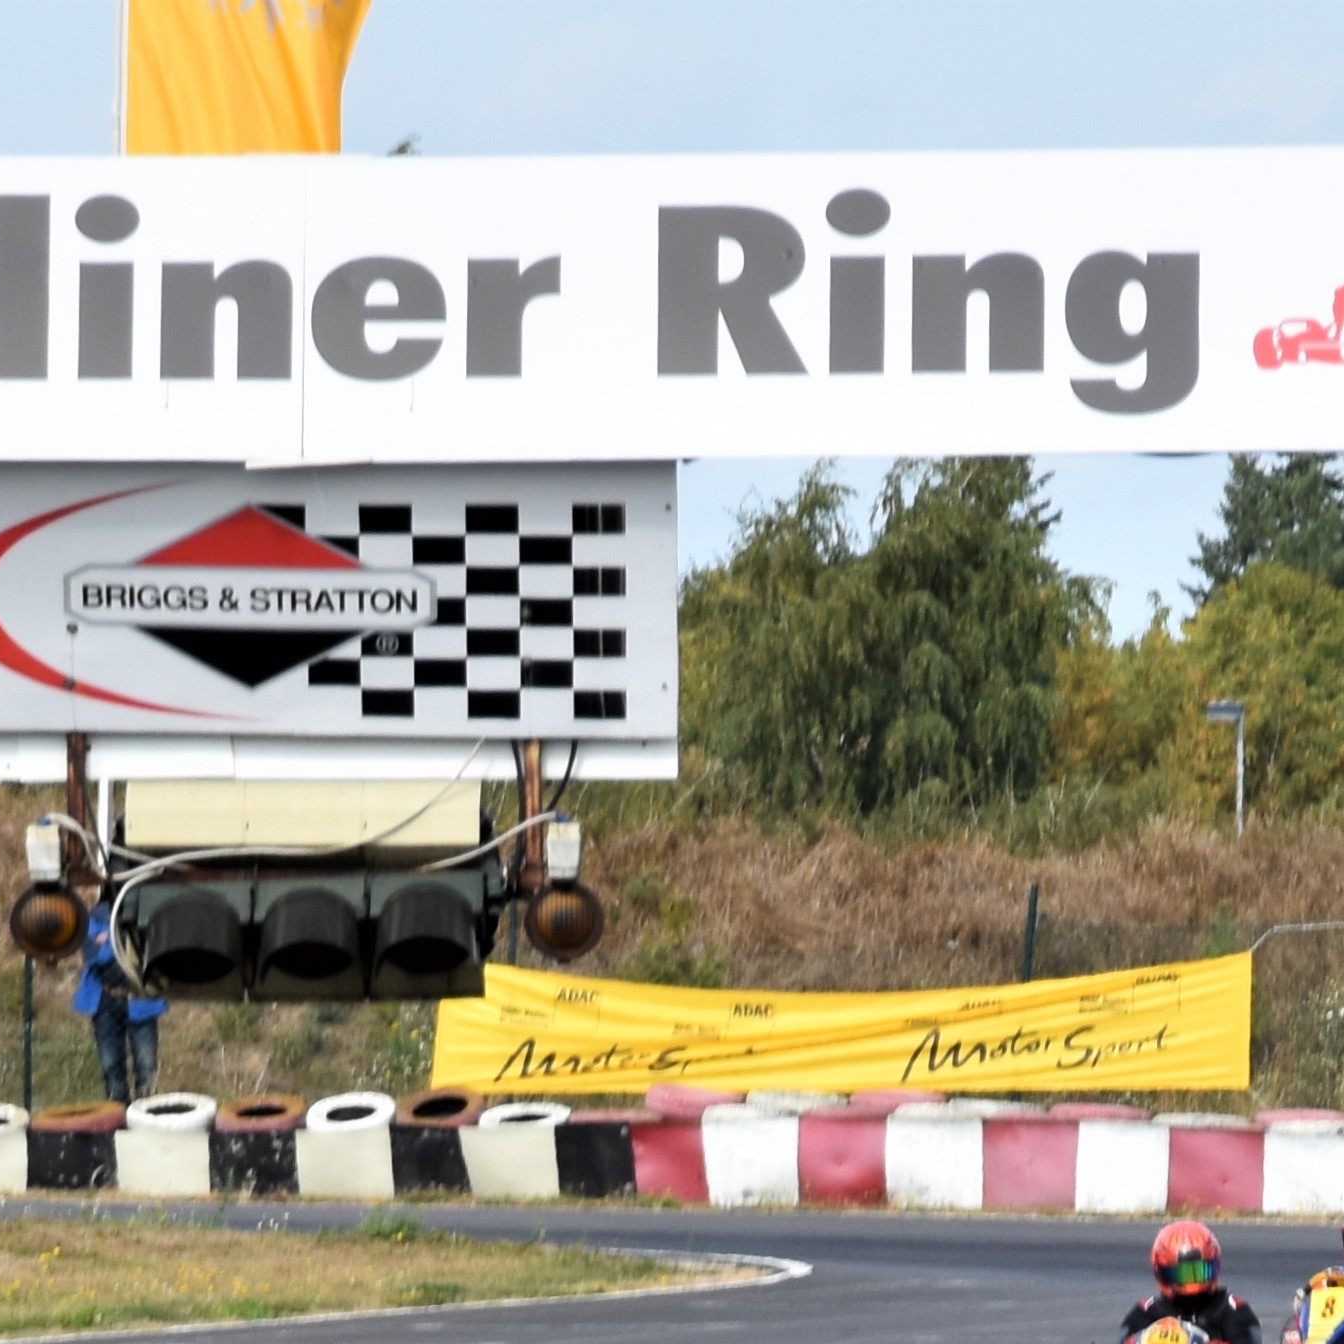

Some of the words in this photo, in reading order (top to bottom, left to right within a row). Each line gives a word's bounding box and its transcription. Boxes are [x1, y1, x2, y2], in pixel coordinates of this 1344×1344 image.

[656, 187, 1201, 414] Ring
[82, 583, 208, 611] BRIGGS
[218, 585, 239, 612] &
[250, 586, 418, 615] STRATTON
[732, 1003, 775, 1018] ADAC
